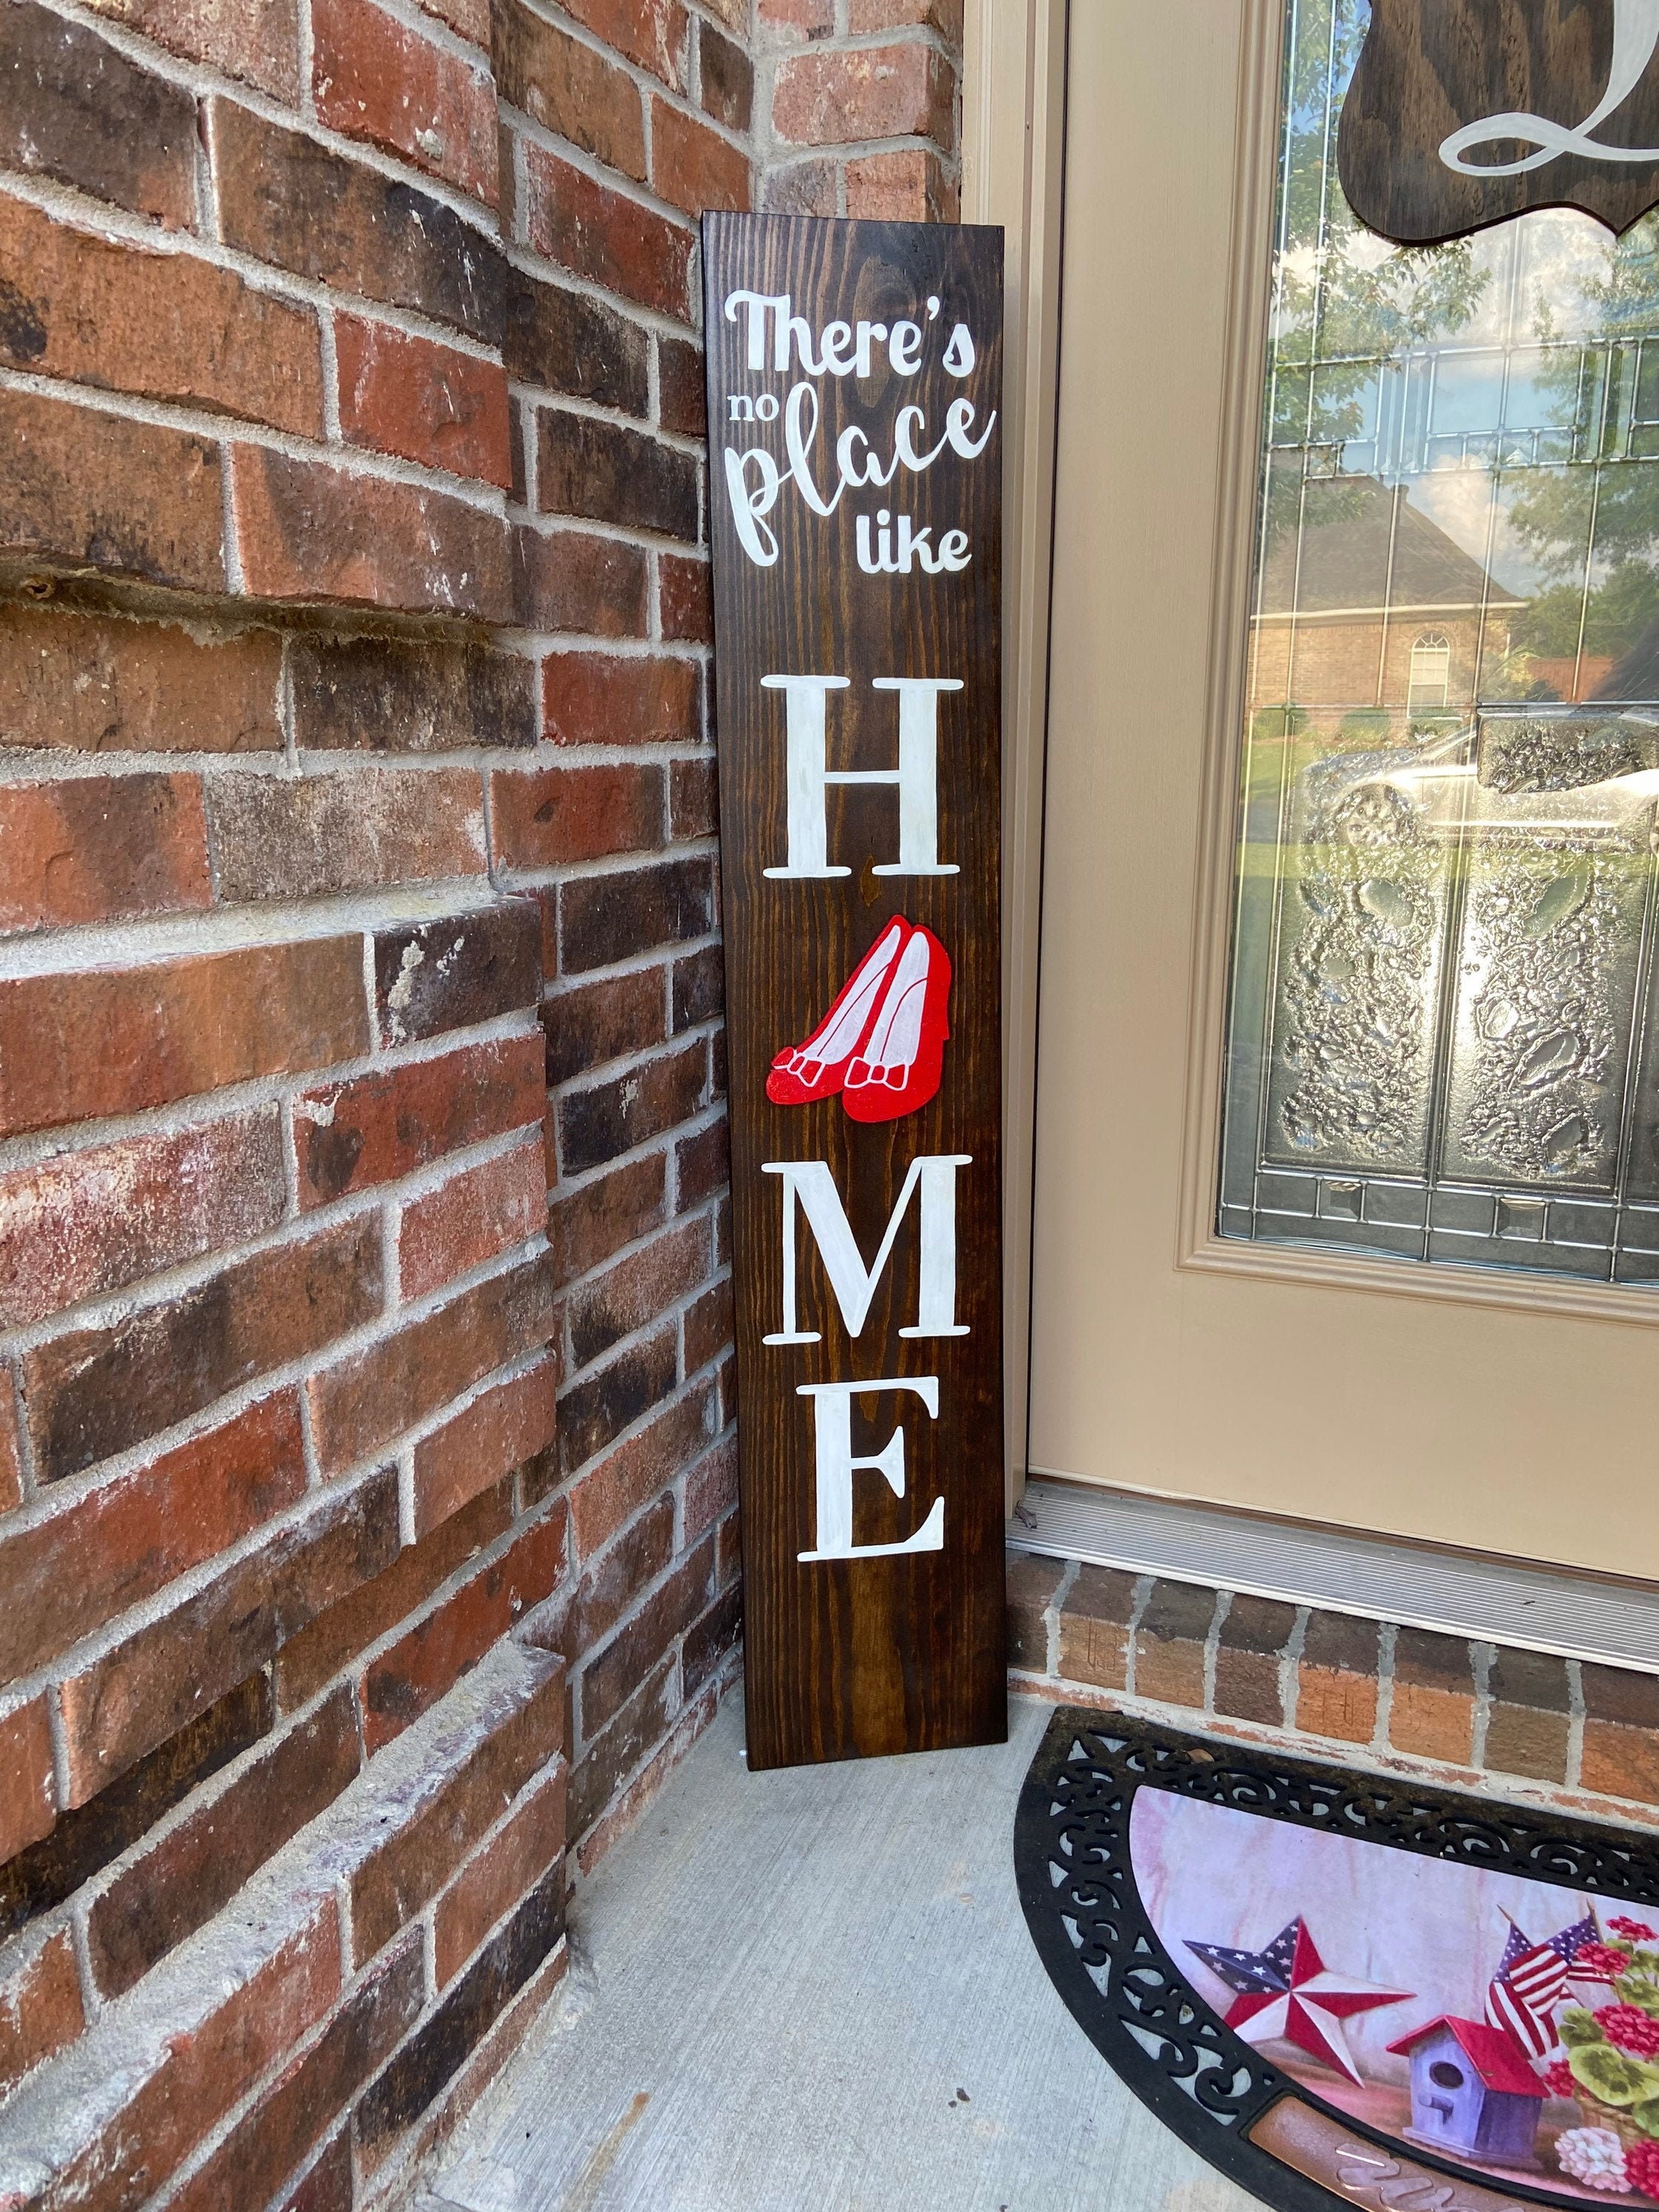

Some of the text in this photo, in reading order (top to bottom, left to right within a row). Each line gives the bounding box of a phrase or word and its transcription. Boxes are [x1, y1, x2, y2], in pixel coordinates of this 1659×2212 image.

[724, 289, 976, 379] There's
[724, 381, 997, 567] no place
[855, 509, 972, 574] like
